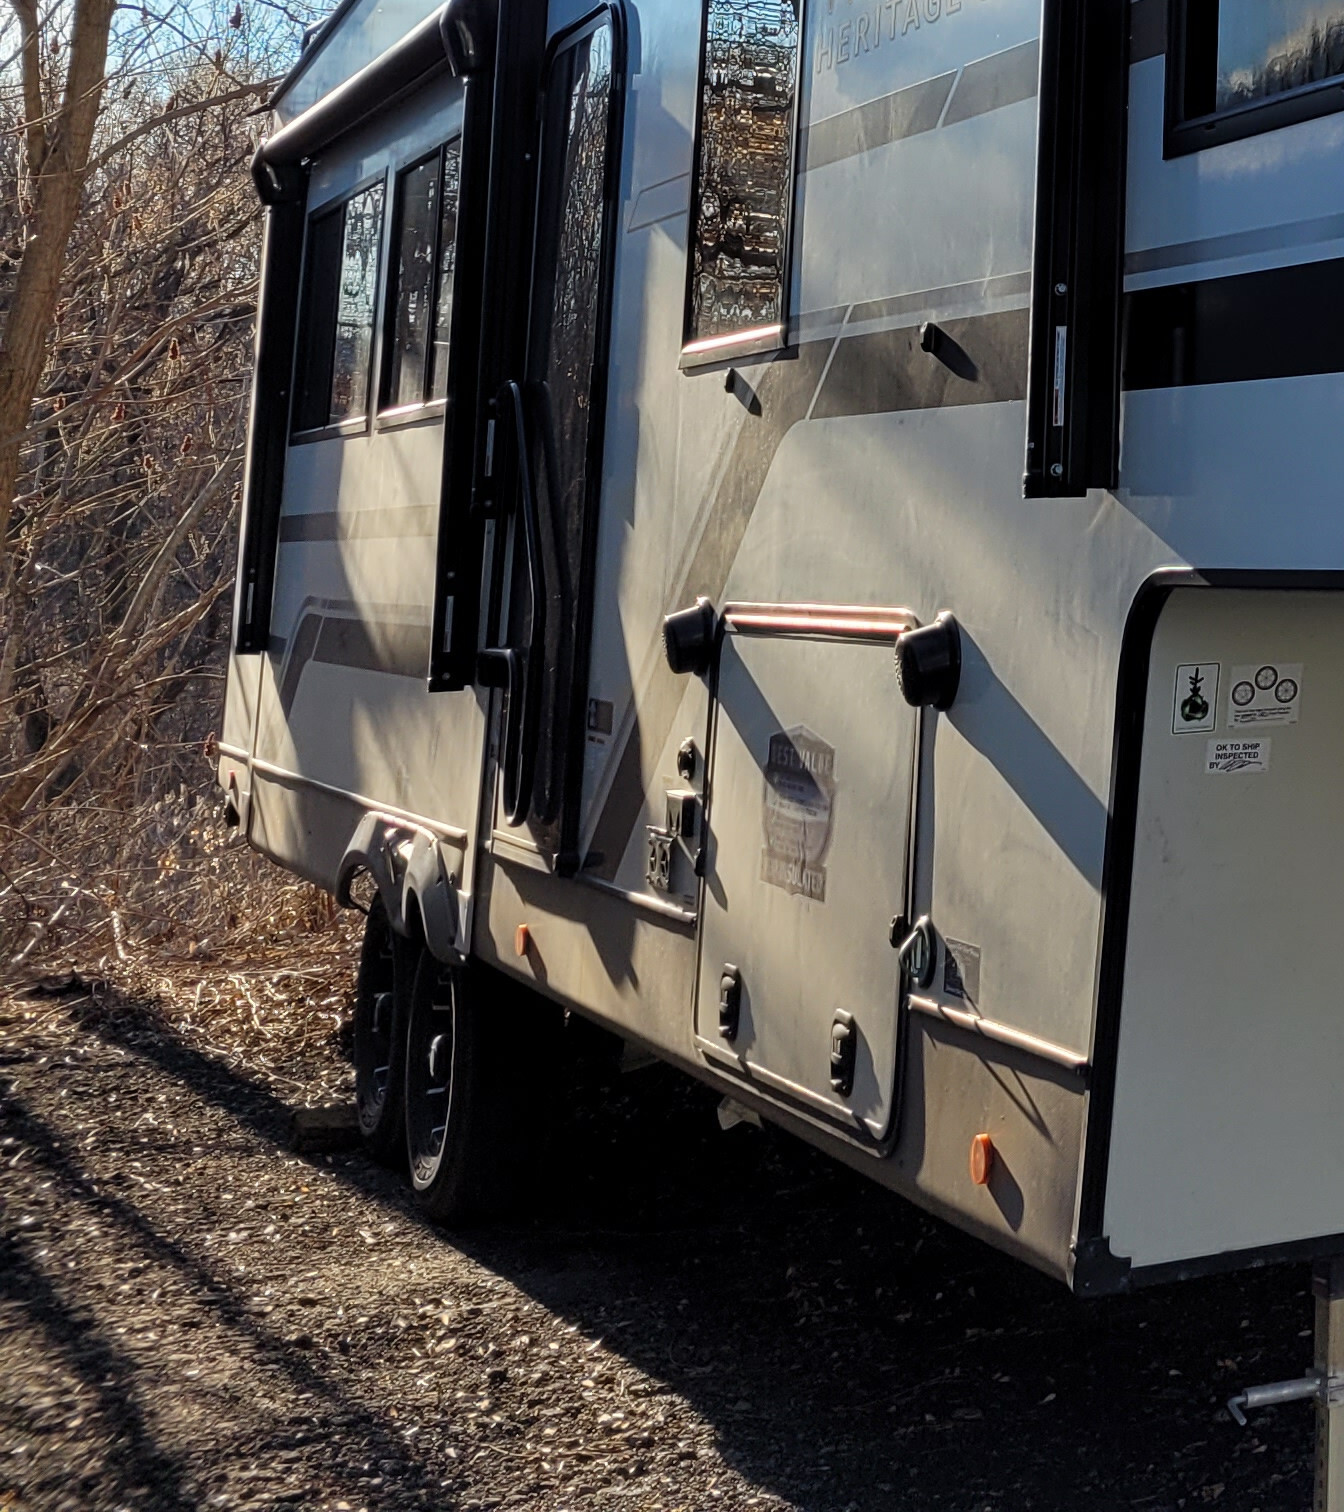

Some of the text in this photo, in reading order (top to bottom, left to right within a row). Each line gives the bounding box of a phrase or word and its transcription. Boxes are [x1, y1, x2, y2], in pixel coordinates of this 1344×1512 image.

[1216, 742, 1261, 752] OK TO SHIP
[1214, 751, 1259, 760] INSPECTED
